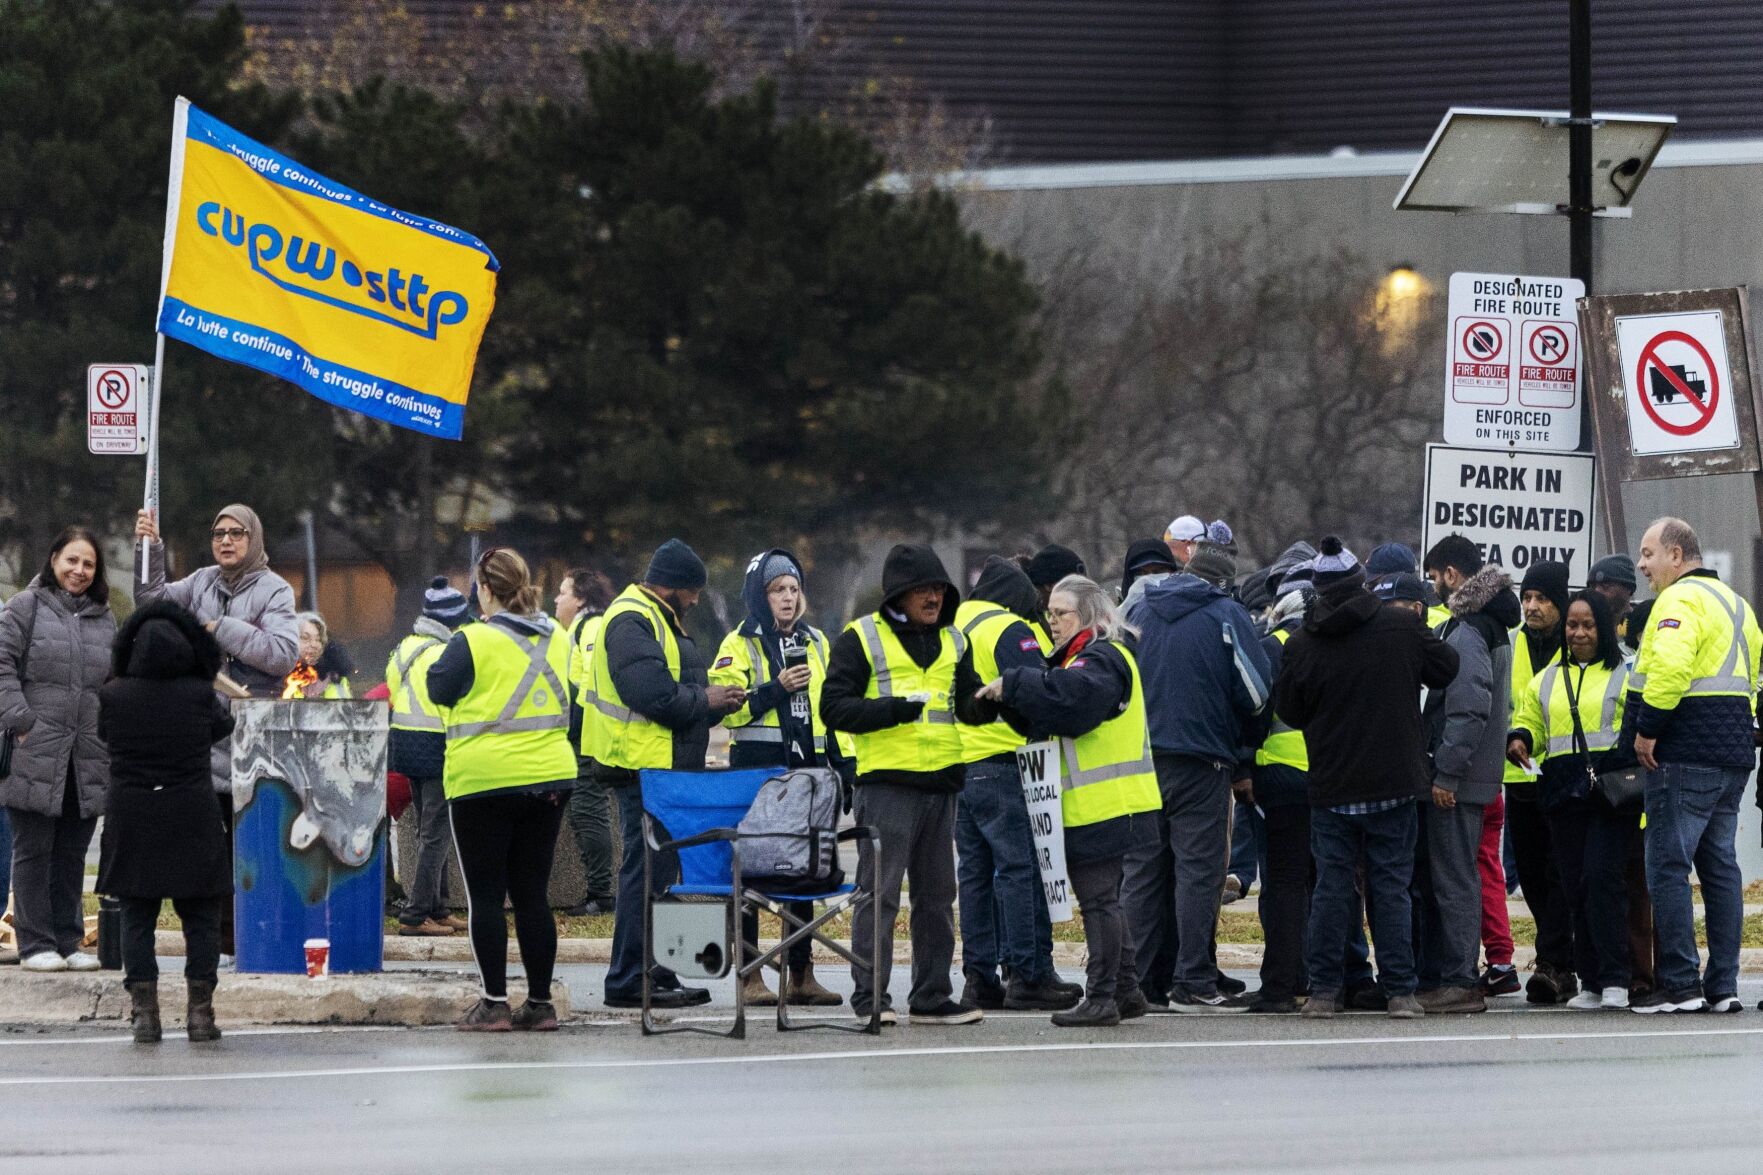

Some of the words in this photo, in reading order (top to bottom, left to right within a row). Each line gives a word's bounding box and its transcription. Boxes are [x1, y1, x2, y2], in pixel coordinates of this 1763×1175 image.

[283, 168, 352, 201] continues
[1473, 280, 1563, 299] DESIGNATED
[1474, 299, 1506, 313] FIRE
[1513, 301, 1561, 316] ROUTE
[176, 308, 195, 328] La
[197, 314, 228, 338] lutte
[232, 330, 293, 361] continue
[302, 356, 319, 379] The
[322, 370, 384, 400] struggle
[385, 391, 442, 420] continues
[1456, 364, 1476, 376] FIRE
[1479, 365, 1507, 378] ROUTE
[1522, 367, 1541, 380] FIRE
[1545, 368, 1573, 381] ROUTE
[92, 413, 108, 424] FIRE
[111, 413, 135, 425] ROUTE
[1476, 409, 1551, 427] ENFORCED
[1476, 428, 1490, 438] ON
[1496, 429, 1520, 440] THIS
[1526, 430, 1550, 442] SITE
[1460, 464, 1527, 491] PARK
[1536, 468, 1562, 493] IN
[1434, 501, 1584, 533] DESIGNATED
[1475, 543, 1503, 568] EA
[1018, 749, 1045, 784] PW
[1030, 785, 1058, 803] LOCAL
[1031, 813, 1052, 837] AND
